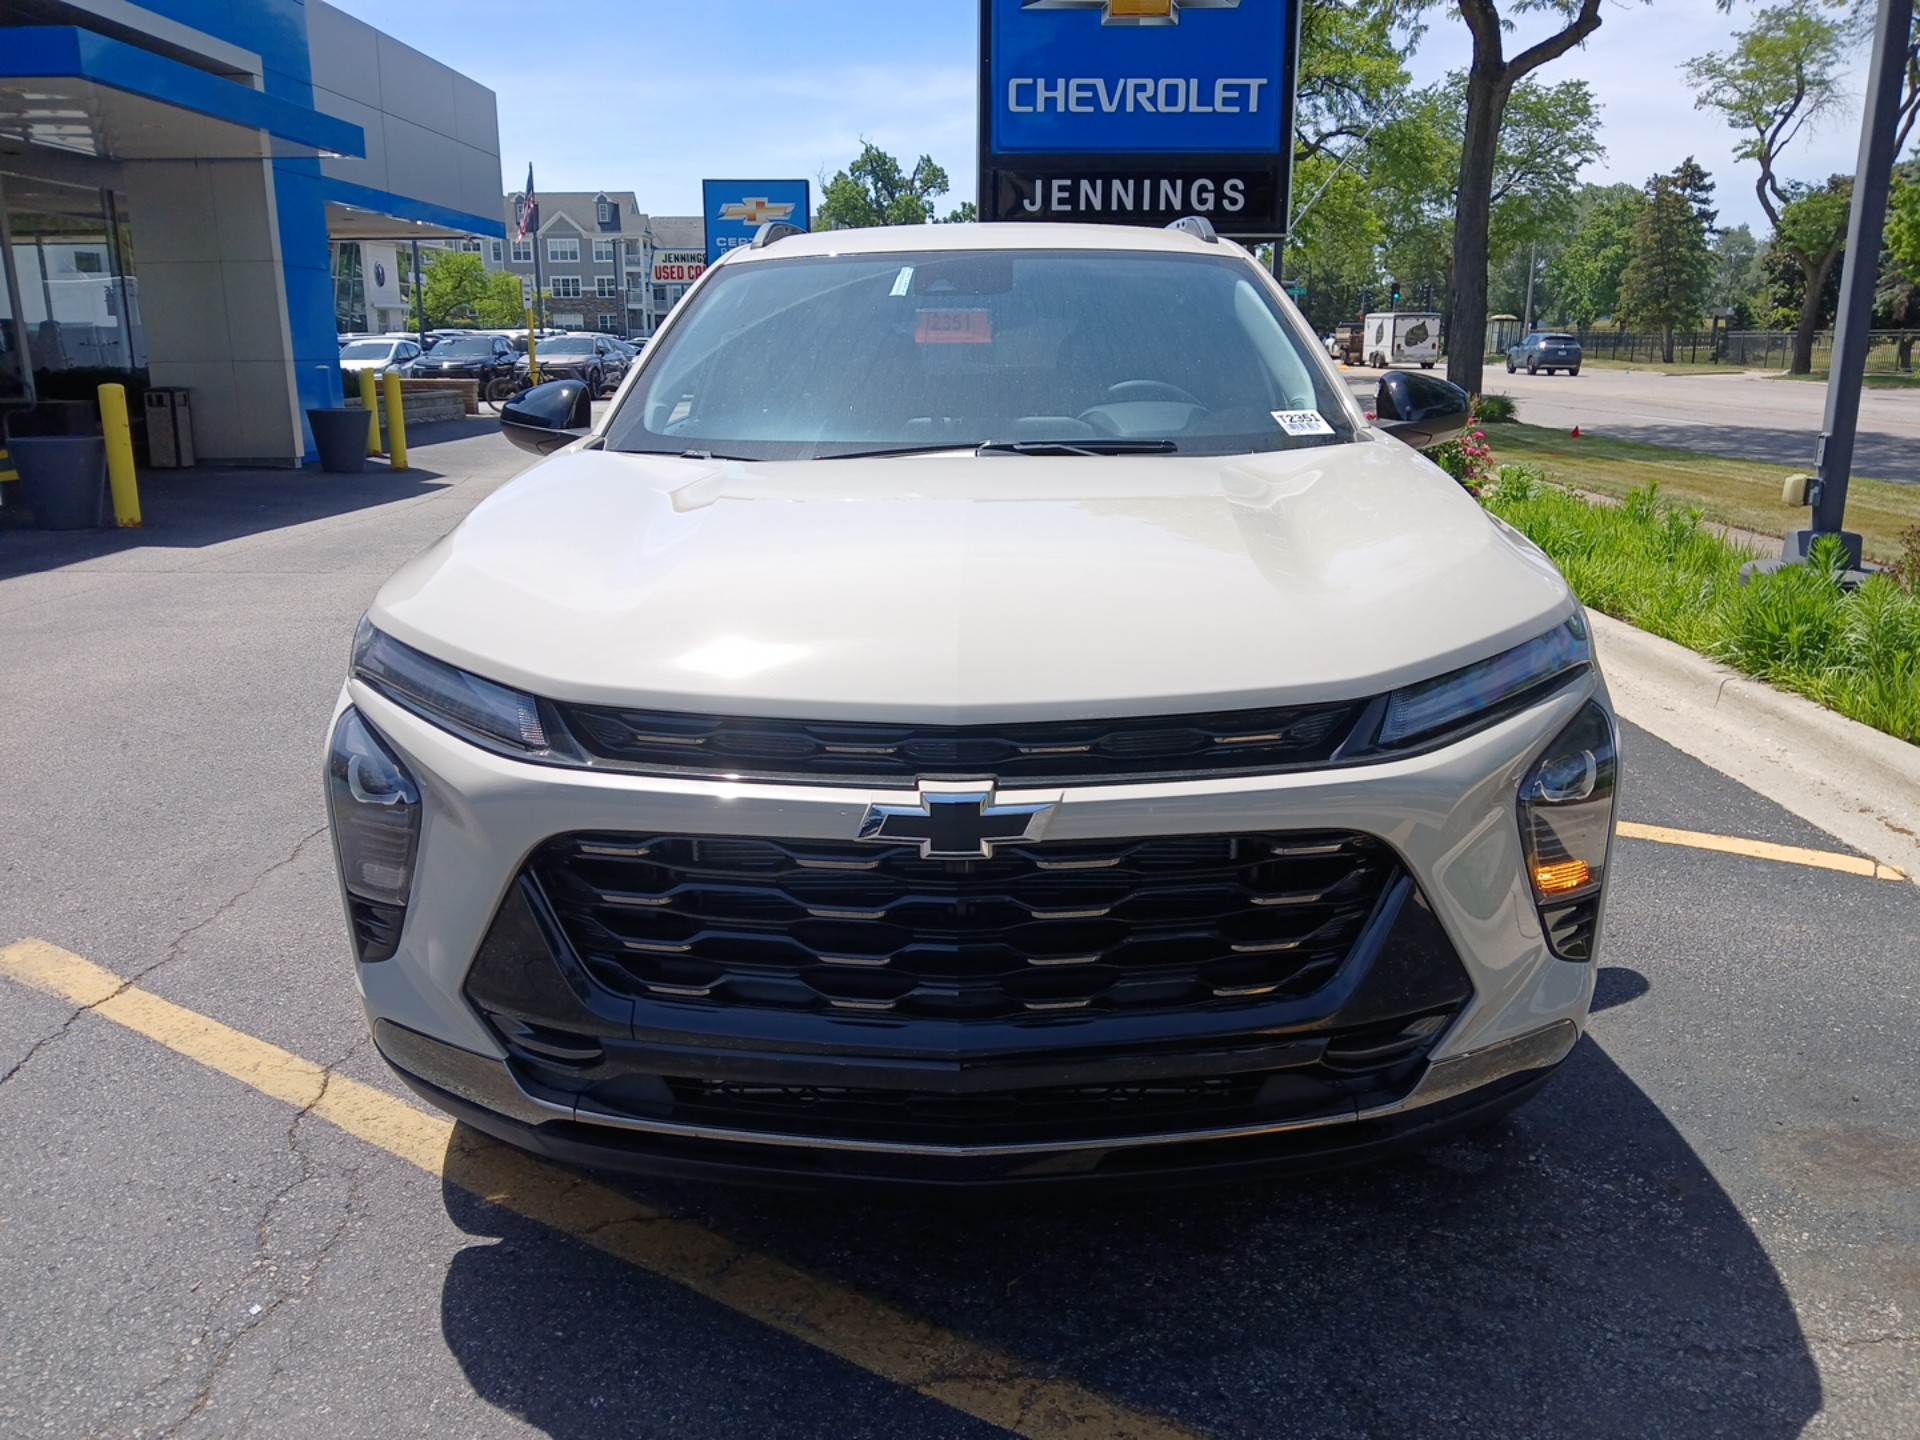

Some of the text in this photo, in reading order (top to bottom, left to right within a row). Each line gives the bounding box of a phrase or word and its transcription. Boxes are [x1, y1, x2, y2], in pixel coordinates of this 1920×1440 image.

[1008, 78, 1268, 113] CHEVROLET
[1023, 178, 1245, 212] JENNINGS
[654, 265, 685, 280] USED
[1276, 413, 1322, 424] T2351
